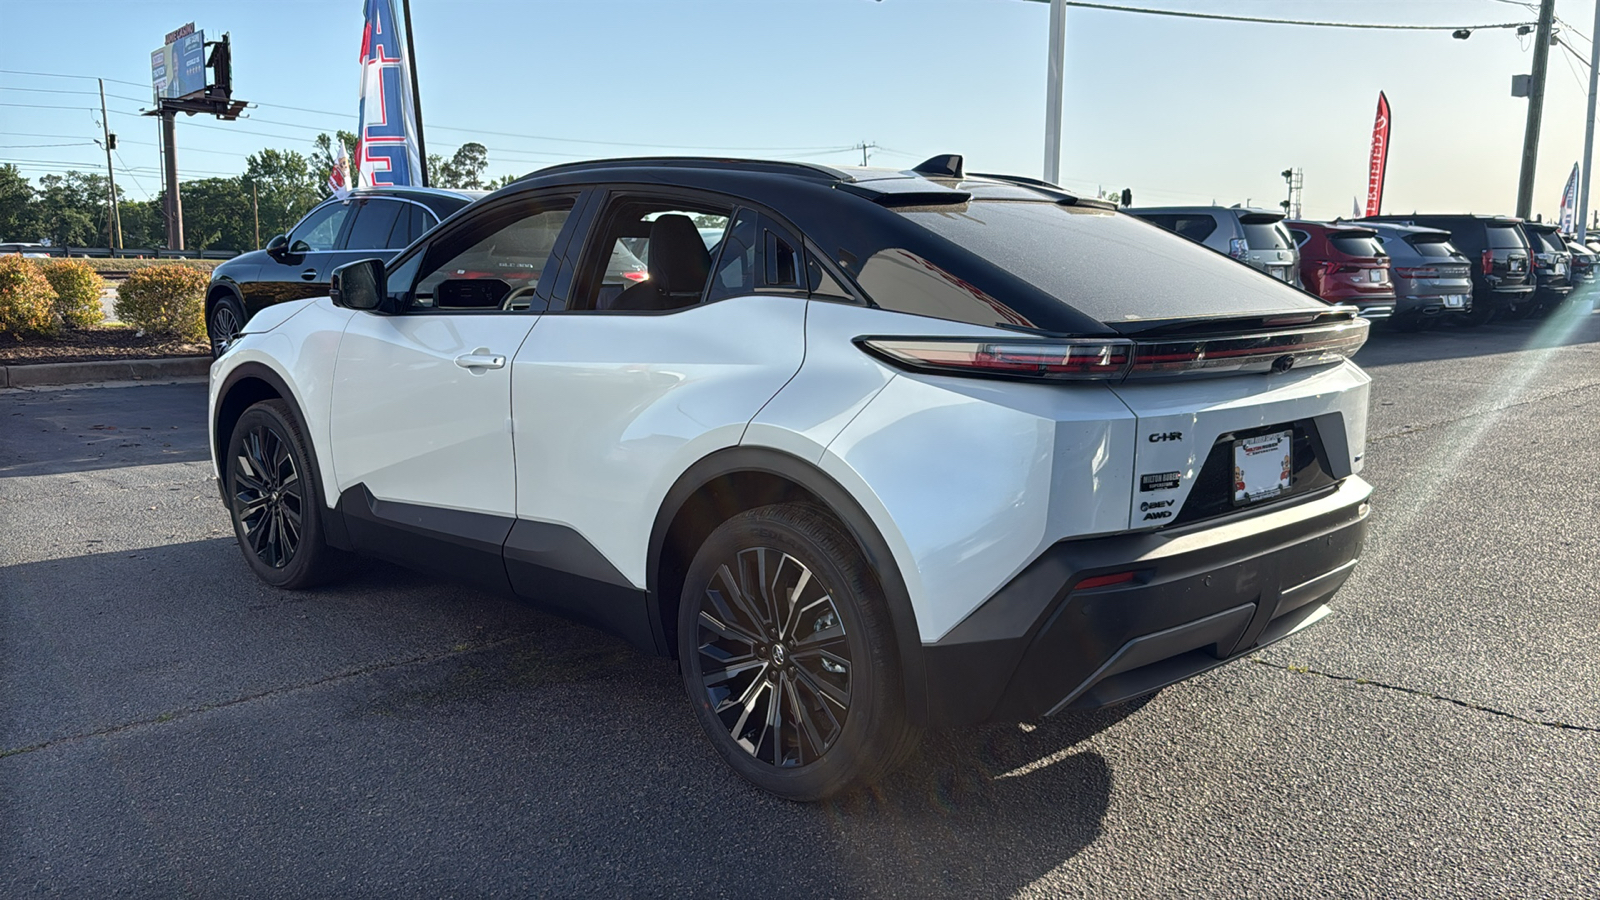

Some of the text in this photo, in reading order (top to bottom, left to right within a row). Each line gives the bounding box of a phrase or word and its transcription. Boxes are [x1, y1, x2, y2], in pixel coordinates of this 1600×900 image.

[1143, 474, 1162, 484] MILTON
[1149, 499, 1175, 509] BEV
[1143, 510, 1173, 521] AWD
